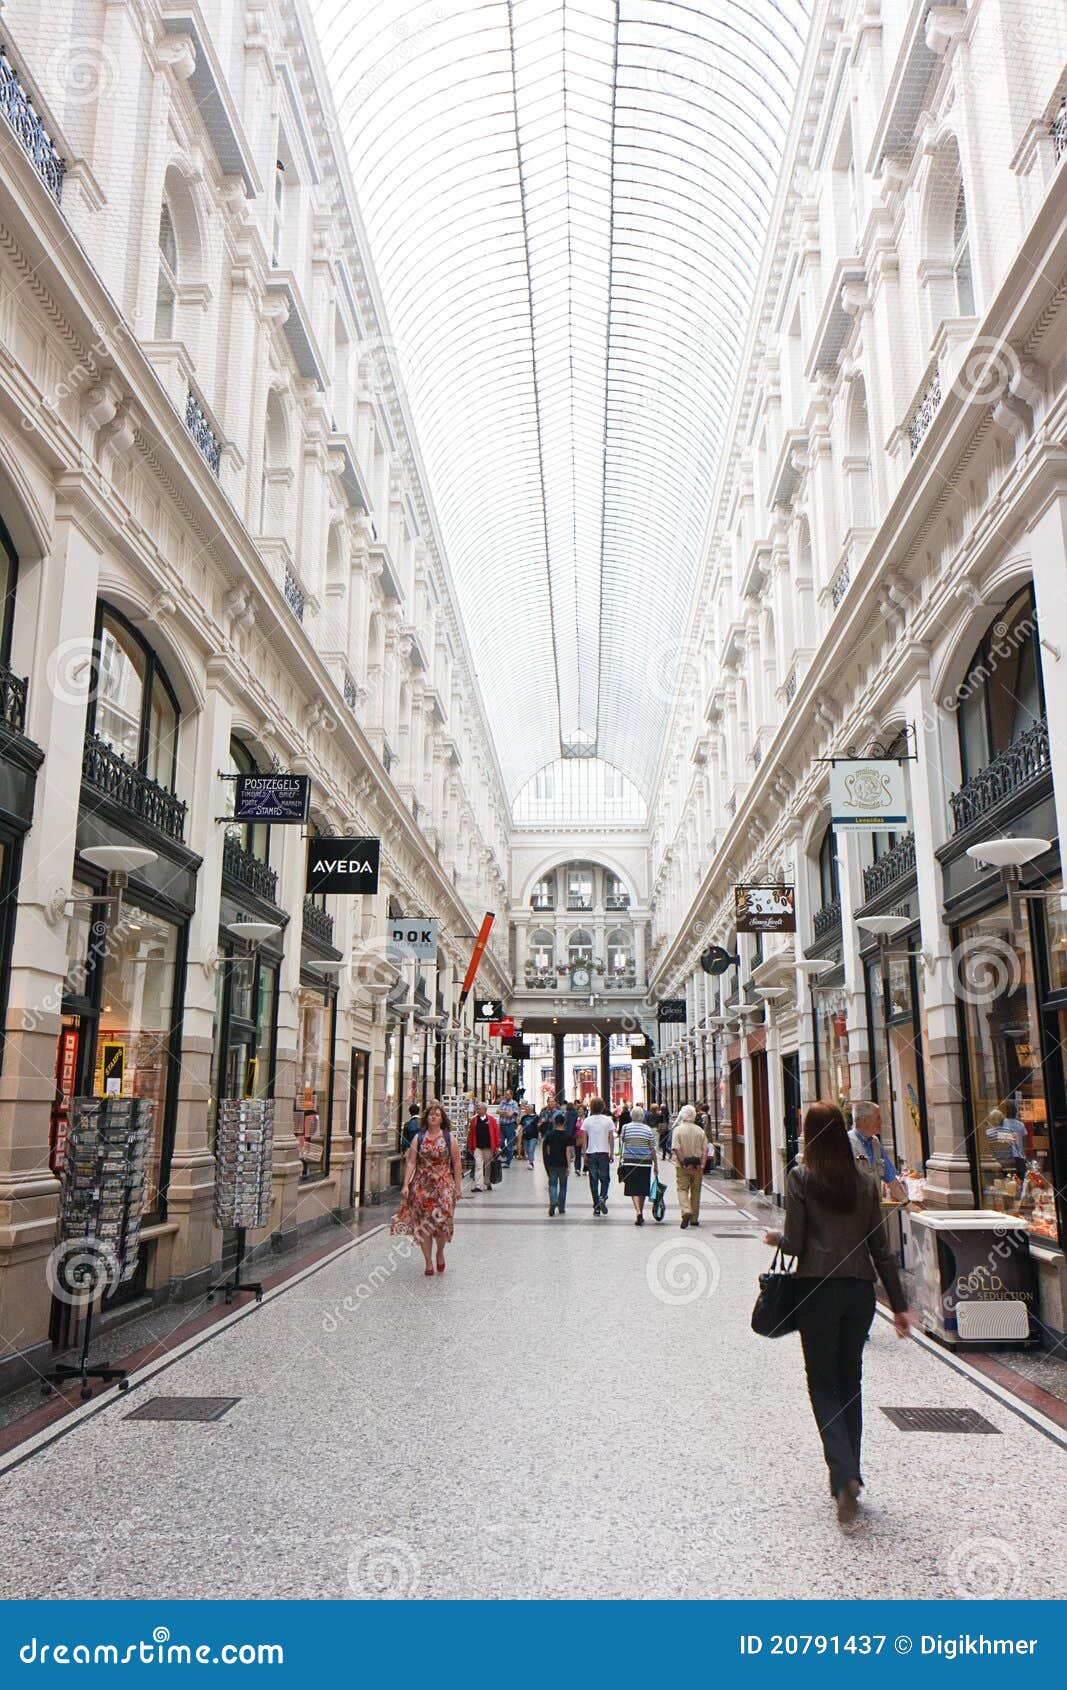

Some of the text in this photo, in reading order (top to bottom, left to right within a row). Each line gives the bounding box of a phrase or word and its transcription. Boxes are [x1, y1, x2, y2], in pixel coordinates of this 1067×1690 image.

[244, 778, 300, 790] POSTZEGELS
[256, 805, 283, 816] STAMPS
[312, 860, 373, 874] AVEDA
[393, 930, 432, 943] DOK
[105, 1048, 123, 1076] STAMPS
[977, 1291, 1034, 1301] SEDUCTION
